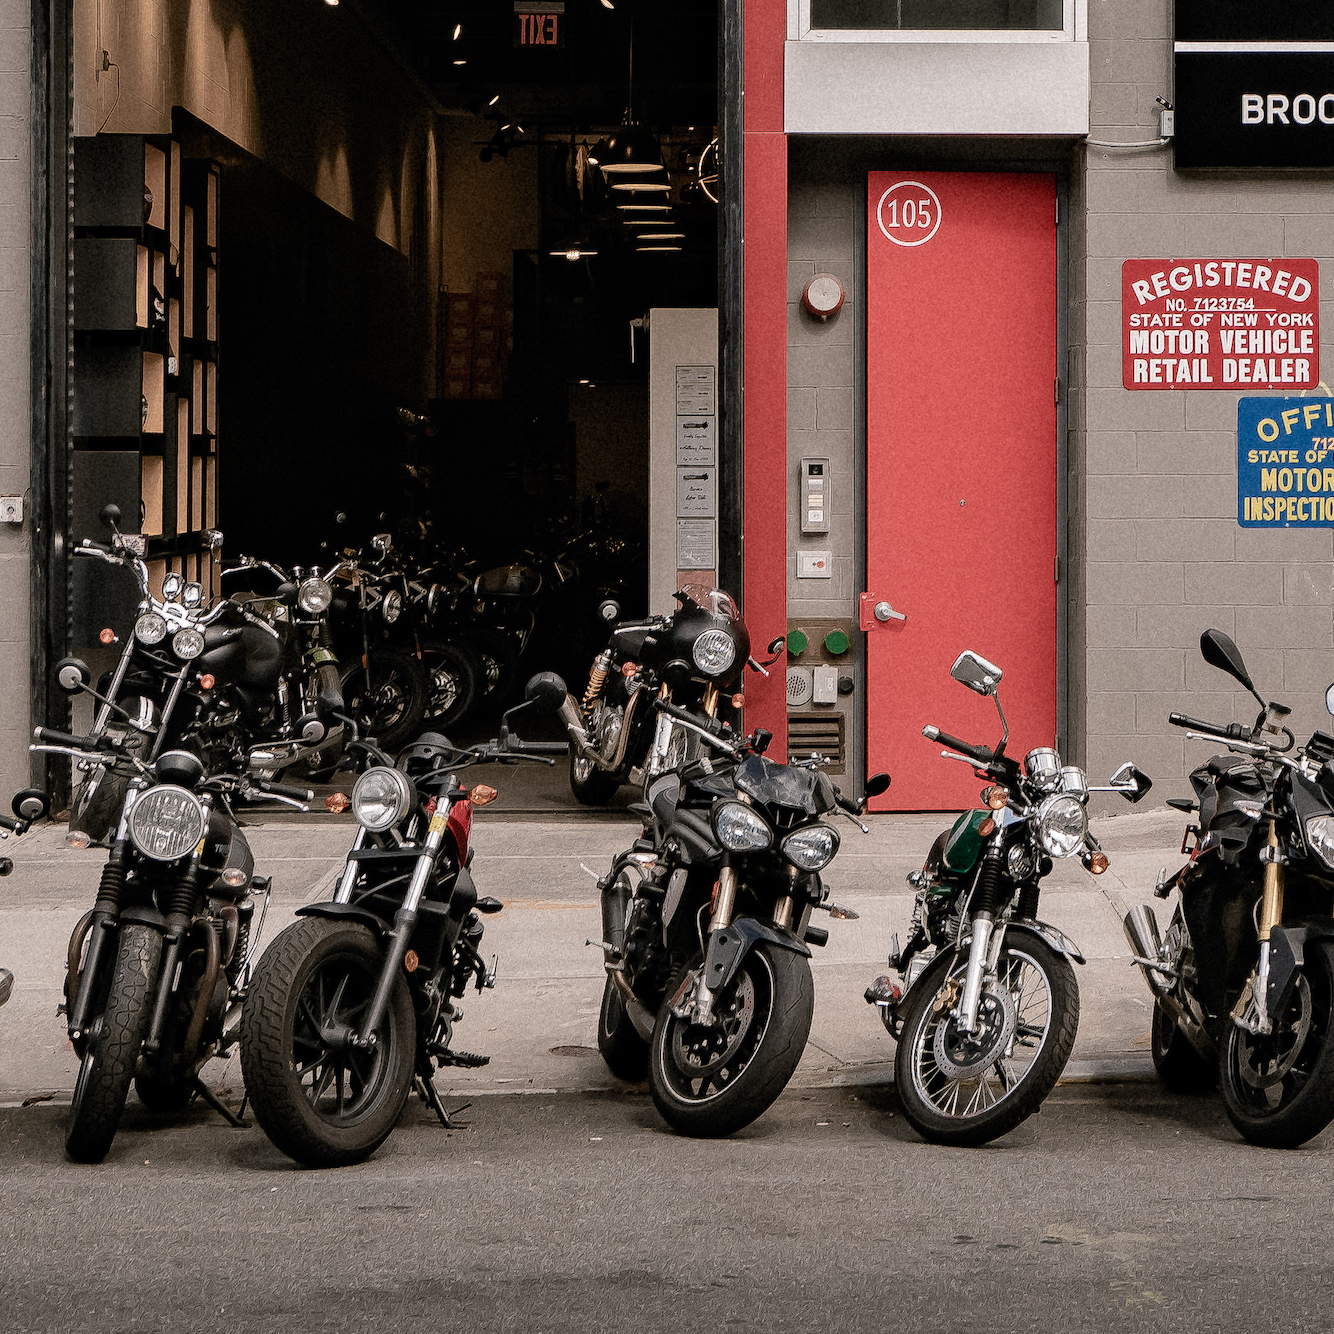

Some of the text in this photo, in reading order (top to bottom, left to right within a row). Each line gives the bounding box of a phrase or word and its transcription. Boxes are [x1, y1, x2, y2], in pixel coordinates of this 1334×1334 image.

[888, 198, 932, 228] 105
[1131, 262, 1312, 305] REGISTERED
[1166, 297, 1255, 311] NO. 7123754
[1129, 313, 1314, 327] STATE OF NEW YORK
[1129, 330, 1314, 354] MOTOR VEHICLE
[1133, 358, 1310, 383] RETAIL DEALER
[1247, 450, 1299, 464] STATE
[1305, 450, 1327, 464] OF
